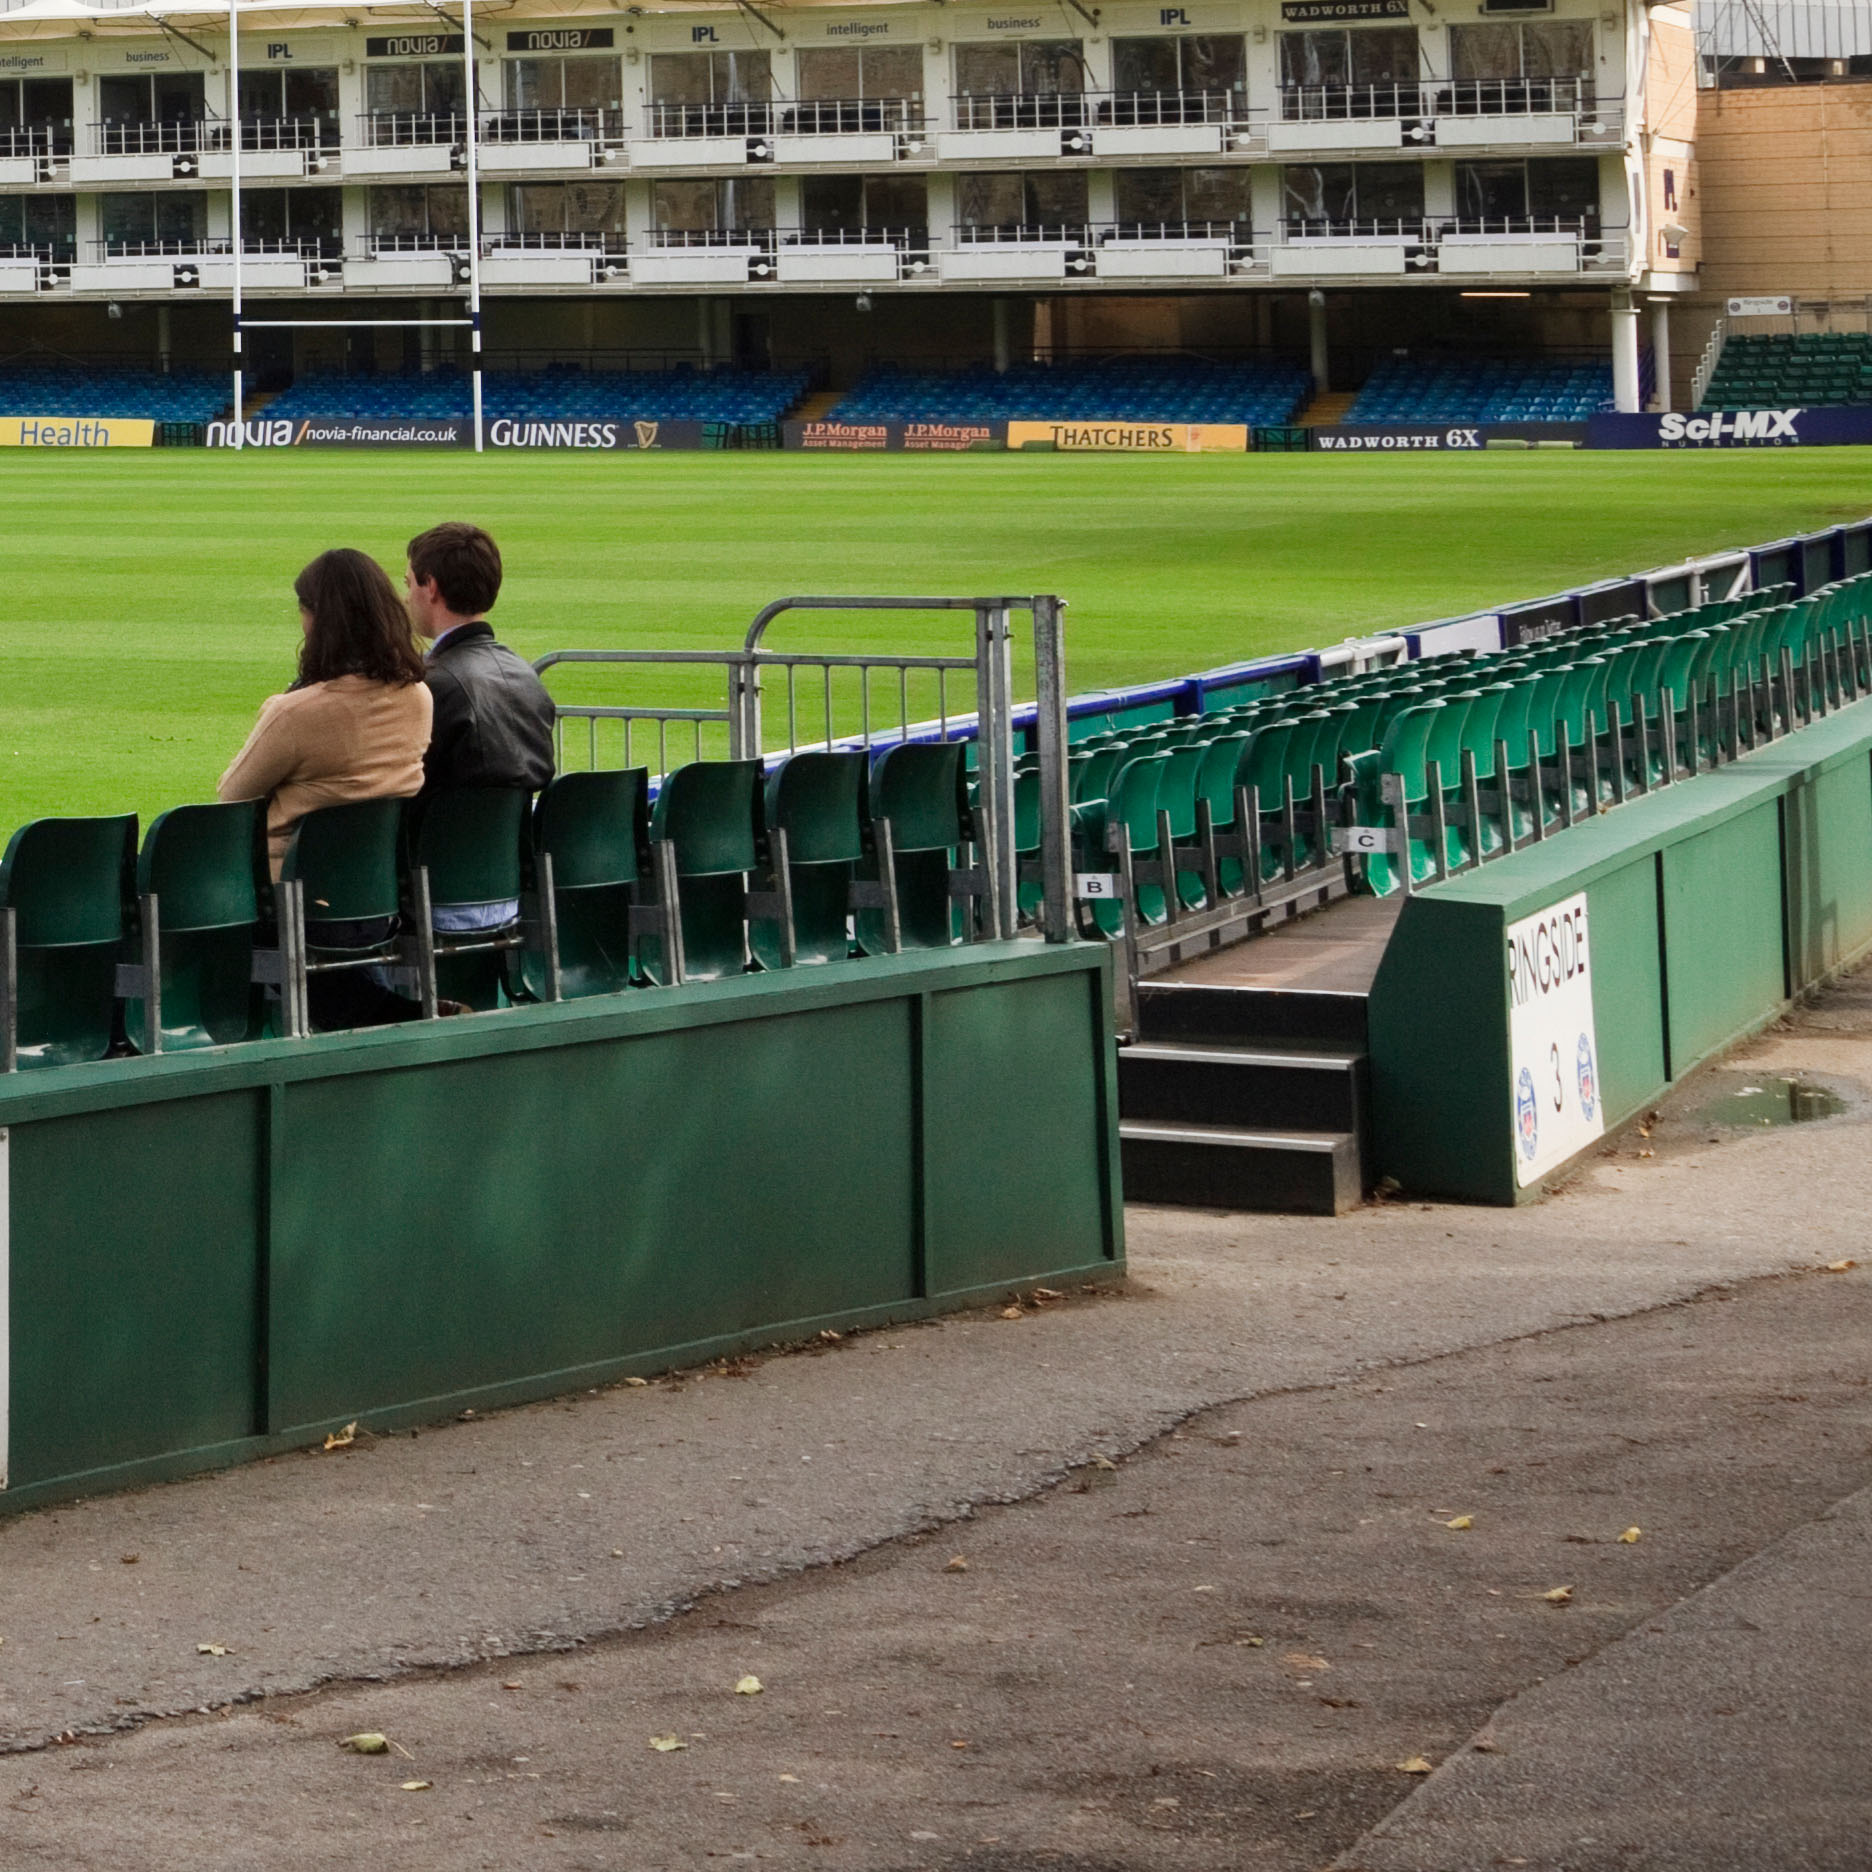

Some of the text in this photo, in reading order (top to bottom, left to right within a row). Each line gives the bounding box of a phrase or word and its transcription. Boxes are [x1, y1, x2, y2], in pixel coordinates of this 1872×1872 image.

[1160, 8, 1190, 25] IPL
[1284, 2, 1383, 18] WADWORTH
[826, 21, 888, 37] intelligent
[987, 16, 1039, 30] business
[692, 26, 719, 42] IPL
[125, 50, 170, 63] business
[267, 42, 293, 59] IPL
[306, 421, 458, 443] novia-financial.co.uk
[802, 423, 887, 440] J.P.Morgan
[904, 424, 990, 441] J.P.Morgan
[1658, 408, 1801, 440] Sci-MX
[20, 421, 109, 448] Health
[490, 419, 617, 449] GUINNESS
[1319, 430, 1479, 448] WADWORTH 6X
[1661, 435, 1800, 448] NUTRITION
[803, 439, 886, 449] Asset Management
[904, 440, 929, 448] Asset
[1358, 832, 1375, 848] C
[1087, 880, 1103, 895] B
[1508, 908, 1584, 1008] RINGSIDE
[1550, 1042, 1563, 1113] 3
